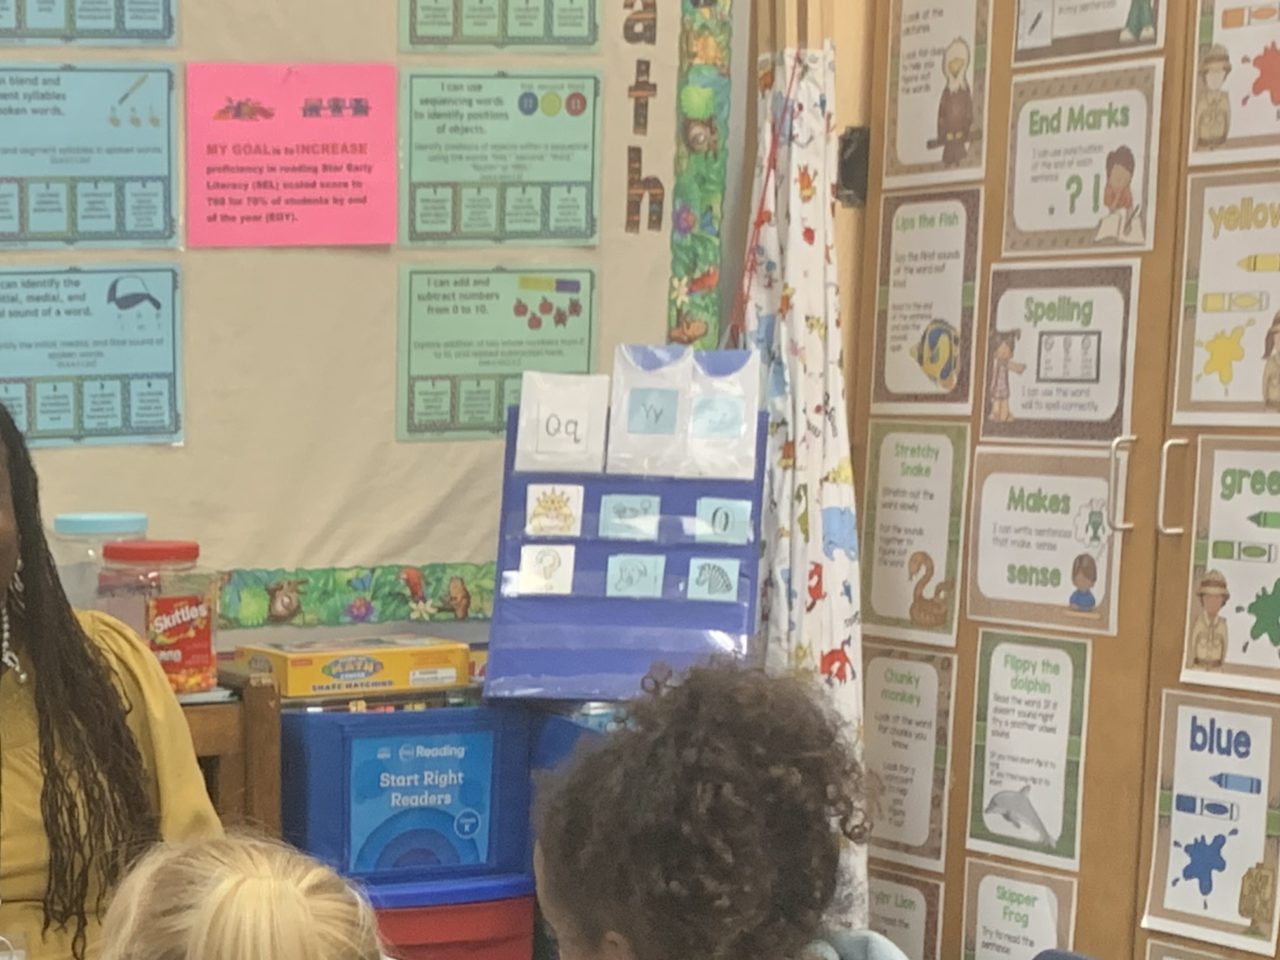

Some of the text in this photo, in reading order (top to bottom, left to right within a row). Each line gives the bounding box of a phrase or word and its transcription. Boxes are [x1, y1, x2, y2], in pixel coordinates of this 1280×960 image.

[41, 76, 61, 86] and
[420, 97, 504, 108] sequencing words
[427, 111, 509, 121] identify positions
[1029, 102, 1130, 136] End Marks
[436, 125, 446, 134] of
[206, 144, 228, 155] MY
[232, 144, 270, 155] GOAL
[296, 143, 368, 155] INCREASE
[206, 164, 264, 175] proficiency
[280, 164, 318, 175] reading
[346, 163, 373, 174] Early
[206, 181, 249, 191] Literacy
[240, 215, 262, 224] year
[919, 214, 935, 230] the
[0, 278, 80, 291] can identify the
[434, 278, 490, 287] can add and
[417, 291, 500, 301] subtract numbers
[8, 308, 38, 317] sound
[41, 307, 52, 317] of
[427, 305, 470, 315] from to
[1024, 296, 1093, 328] Spelling
[895, 444, 939, 461] Stretchy
[901, 462, 931, 478] Snake
[1007, 486, 1071, 514] Makes
[1007, 564, 1061, 588] sense
[153, 603, 208, 633] Skittles
[1004, 654, 1060, 676] Flippy the
[1010, 676, 1051, 694] dolphin
[881, 689, 921, 708] monkey
[1190, 715, 1252, 759] blue
[416, 745, 465, 759] Reading
[380, 769, 464, 787] Start Right
[391, 791, 452, 807] Readers
[996, 885, 1038, 907] Skipper
[1003, 906, 1029, 928] Frog
[1003, 932, 1020, 943] read
